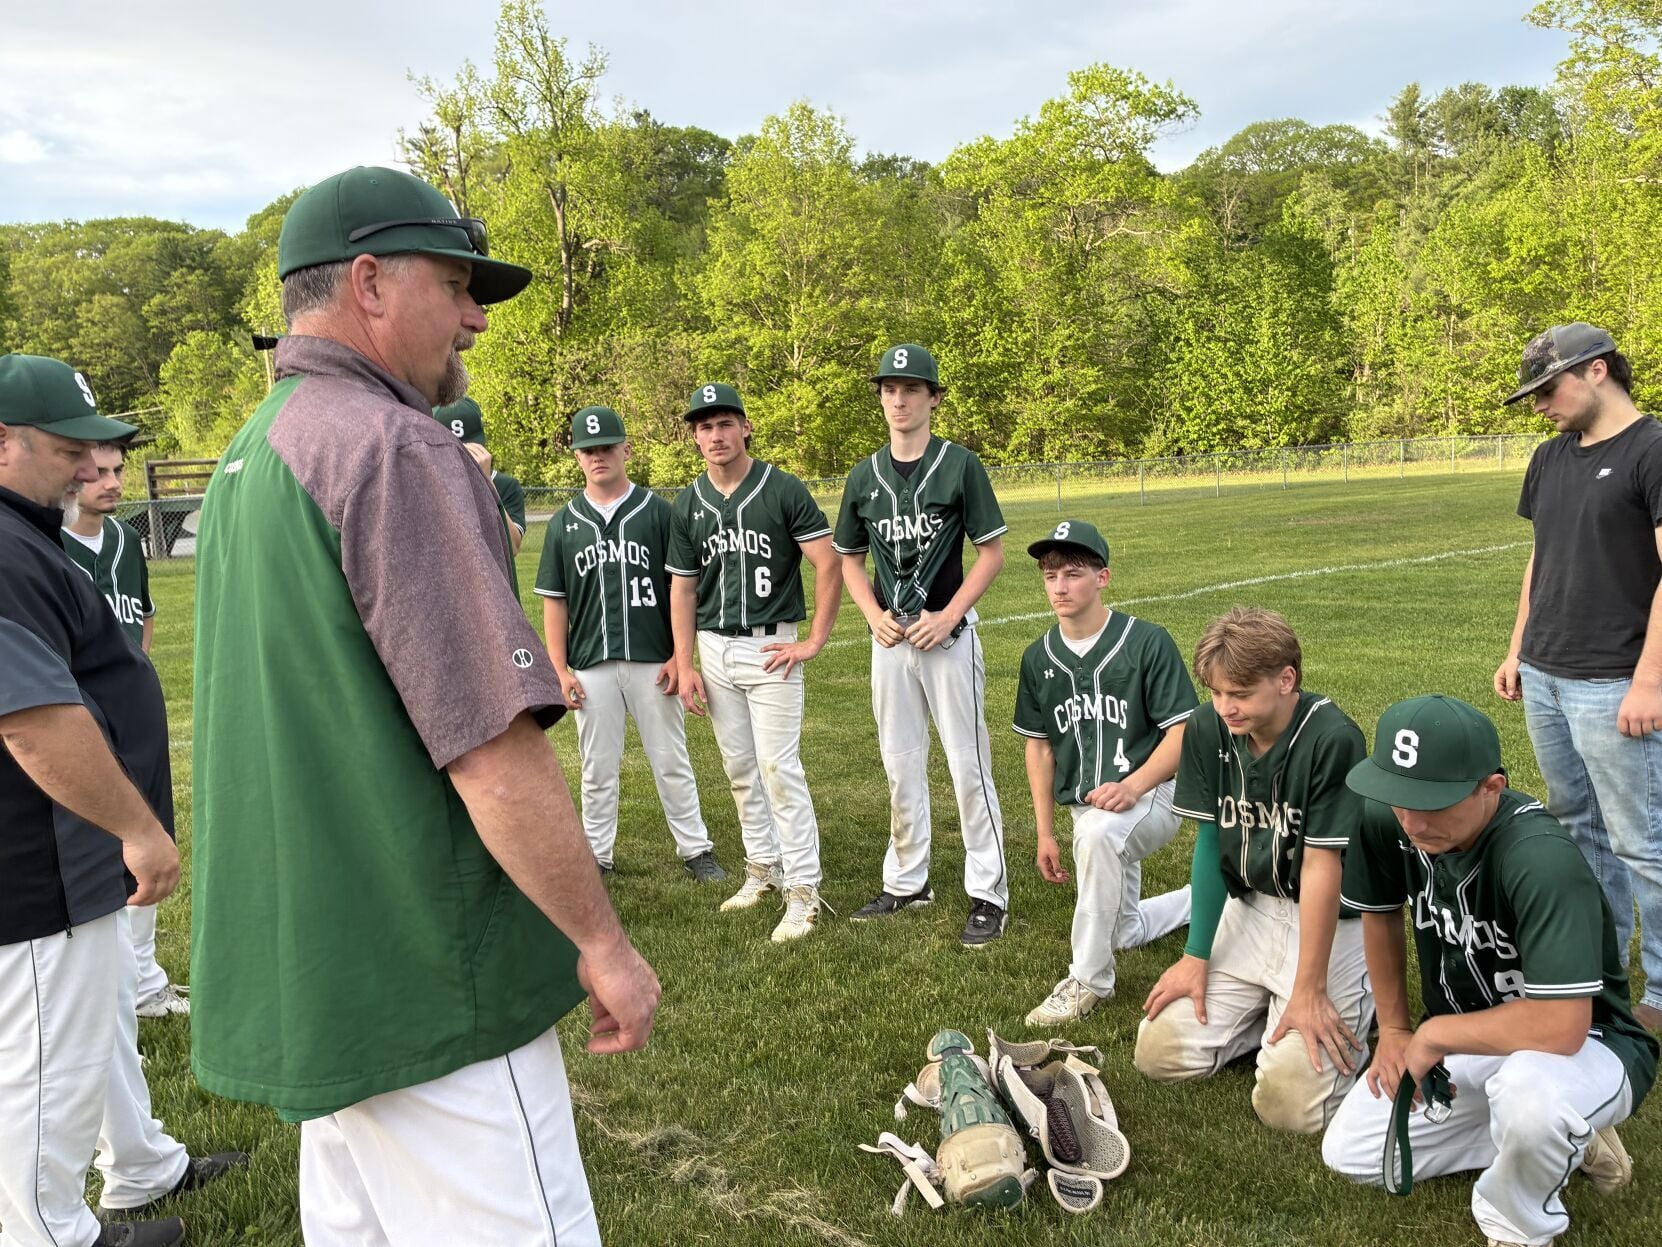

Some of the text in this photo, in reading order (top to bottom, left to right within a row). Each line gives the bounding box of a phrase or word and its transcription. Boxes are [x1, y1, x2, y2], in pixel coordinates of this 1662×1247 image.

[893, 348, 909, 369] S
[75, 372, 96, 407] S
[703, 384, 717, 403] S
[450, 419, 465, 438] S
[585, 414, 601, 435] S
[1054, 521, 1071, 540] S
[574, 539, 650, 577] COSMOS
[629, 576, 658, 607] 13
[754, 566, 772, 598] 6
[1113, 738, 1131, 773] 4
[1392, 728, 1420, 769] S
[1494, 969, 1526, 1003] 9
